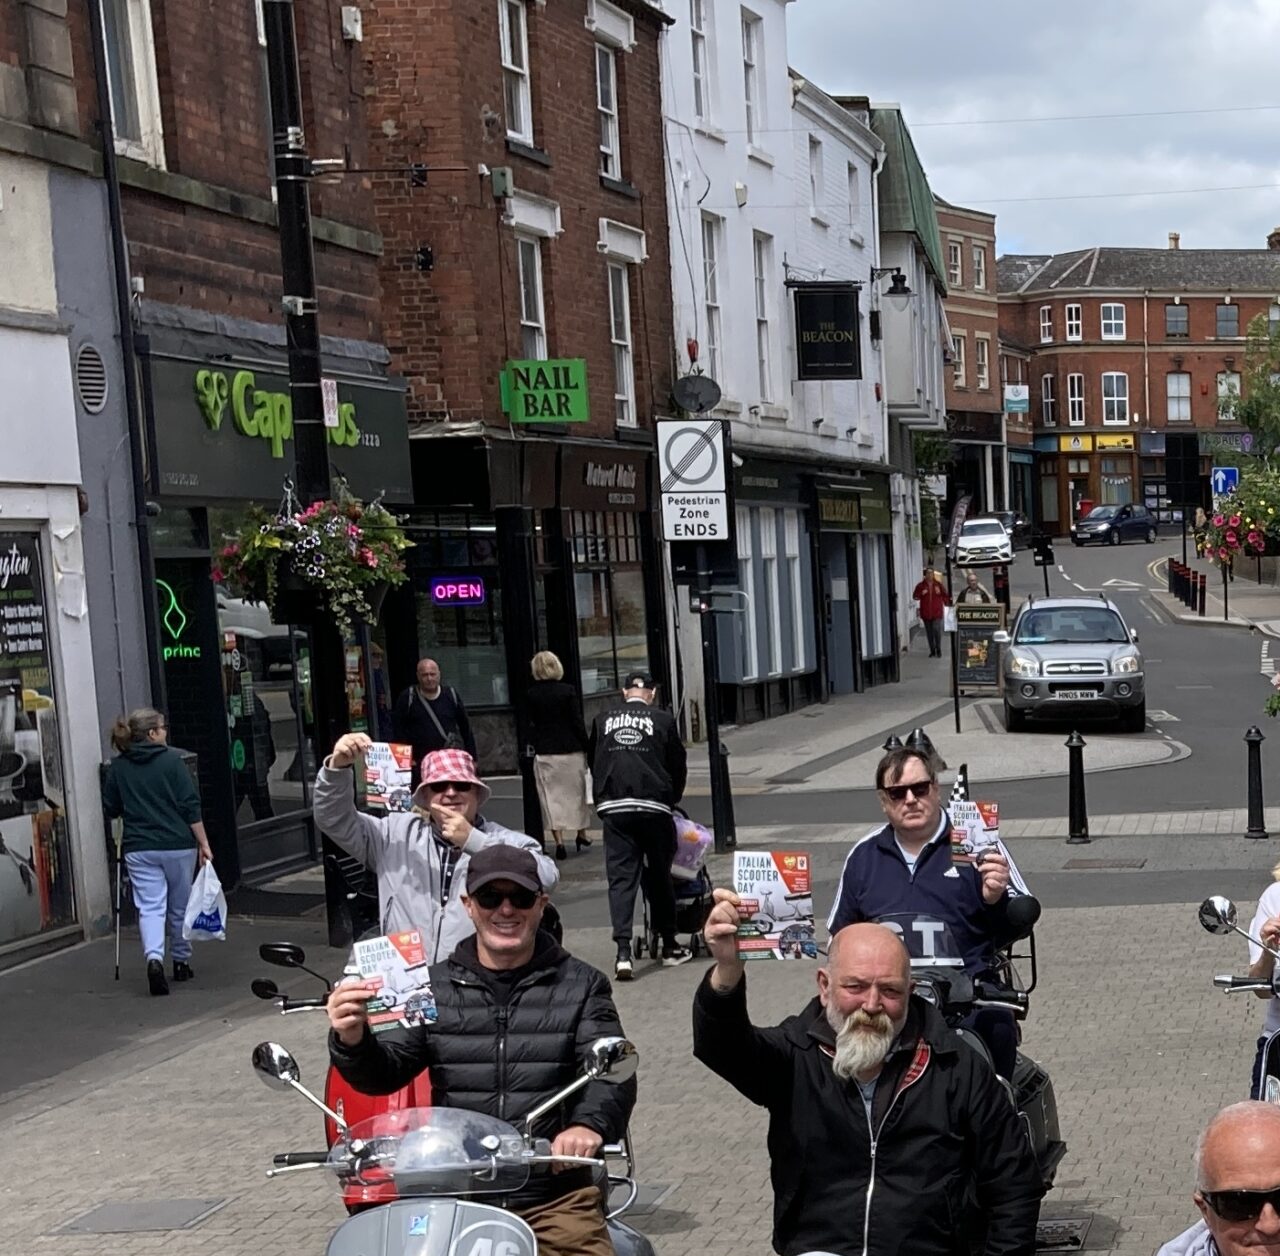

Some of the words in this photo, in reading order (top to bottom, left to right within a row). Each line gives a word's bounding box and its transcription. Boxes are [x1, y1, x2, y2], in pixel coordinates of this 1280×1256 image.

[819, 322, 836, 330] THE
[802, 331, 854, 343] BEACON
[512, 366, 579, 390] NAIL
[523, 393, 572, 417] BAR
[668, 496, 721, 506] Pedestrian
[679, 508, 710, 519] Zone
[674, 523, 718, 536] ENDS
[435, 584, 481, 599] OPEN
[738, 856, 772, 868] ITALIAN
[737, 870, 779, 881] SCOOTER
[737, 882, 755, 893] DAY
[359, 940, 390, 955] ITALIAN
[360, 949, 397, 965] SCOOTER
[362, 964, 378, 974] DAY
